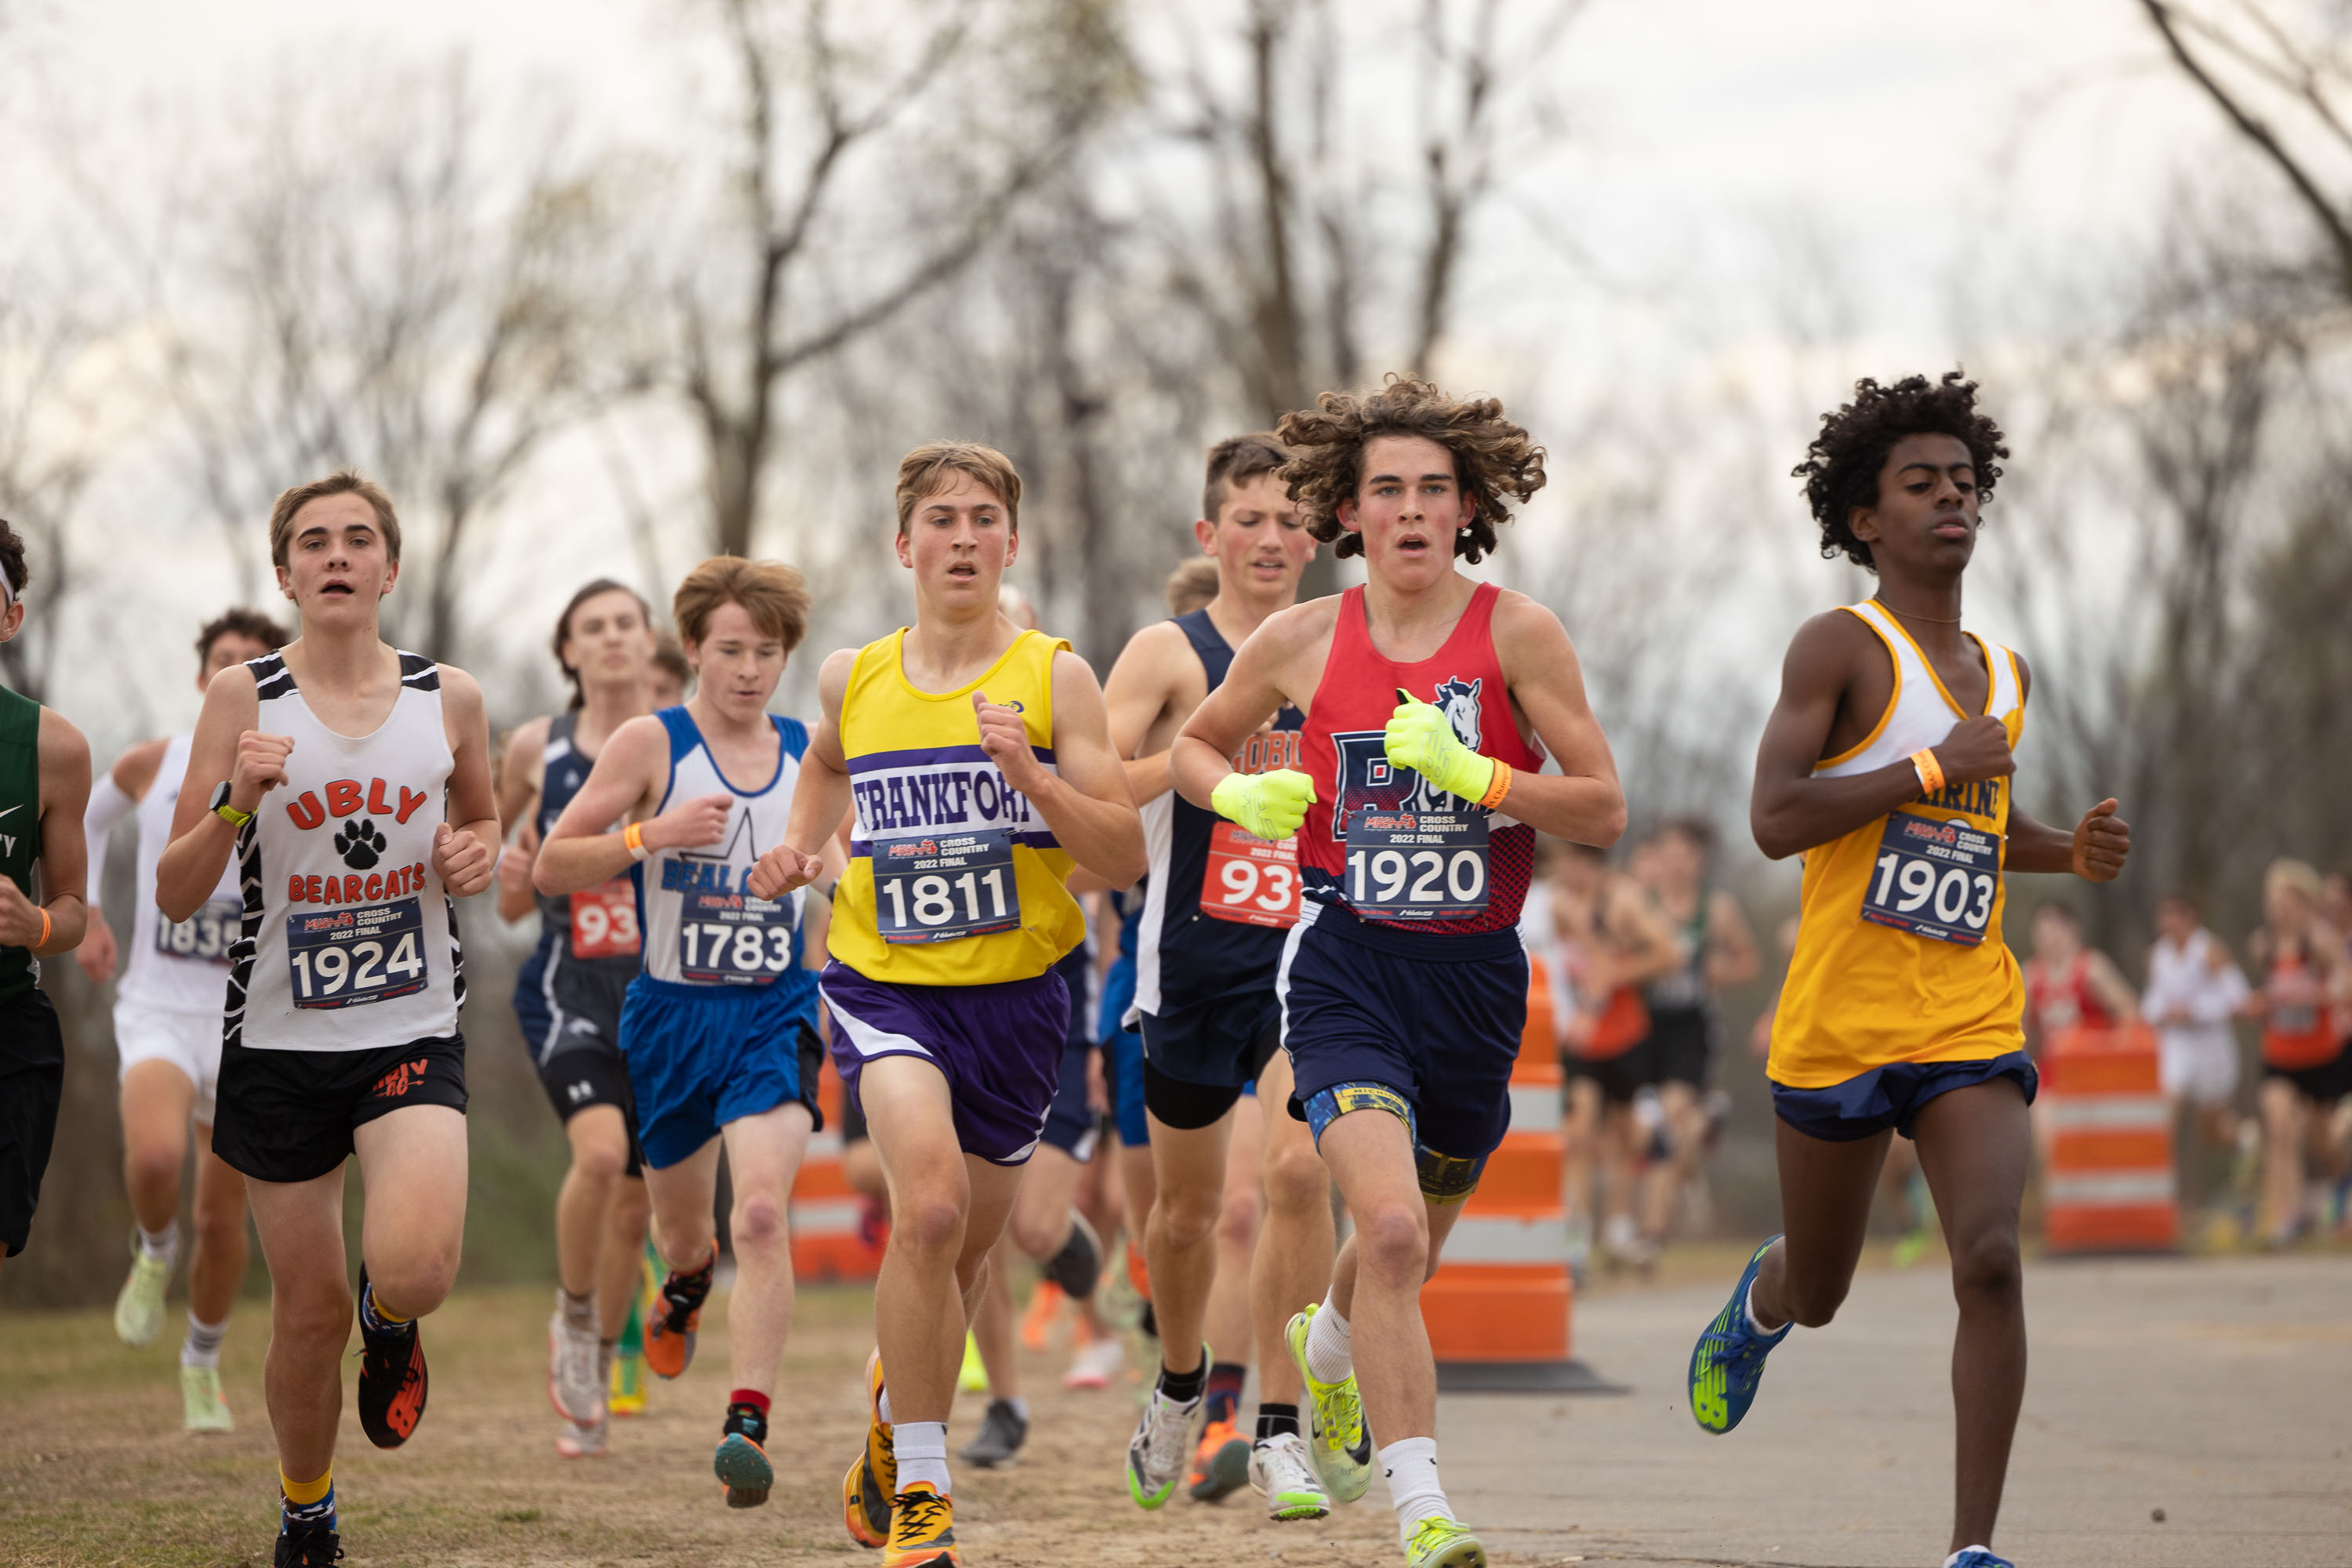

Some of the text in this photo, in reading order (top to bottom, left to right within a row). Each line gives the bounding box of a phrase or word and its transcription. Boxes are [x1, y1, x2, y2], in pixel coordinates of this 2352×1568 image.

[286, 777, 427, 830] UBLY
[1420, 815, 1456, 824] CROSS
[1420, 824, 1468, 833] COUNTRY
[940, 837, 975, 848] CROSS
[1390, 834, 1445, 844] 2022 FINAL
[1958, 831, 1987, 845] CROSS
[941, 844, 989, 856] COUNTRY
[1926, 844, 1974, 864] 2022 FINAL
[1957, 840, 1994, 856] COUNTRY
[913, 857, 967, 869] 2022 FINAL
[289, 862, 425, 905] BEARCATS
[1348, 850, 1484, 902] 1920
[1221, 860, 1303, 912] 93
[1875, 853, 1994, 929] 1903
[883, 869, 1007, 927] 1811
[357, 907, 391, 919] CROSS
[357, 912, 402, 926] COUNTRY
[330, 926, 382, 940] 2022 FINAL
[683, 923, 791, 972] 1783
[292, 932, 423, 997] 1924
